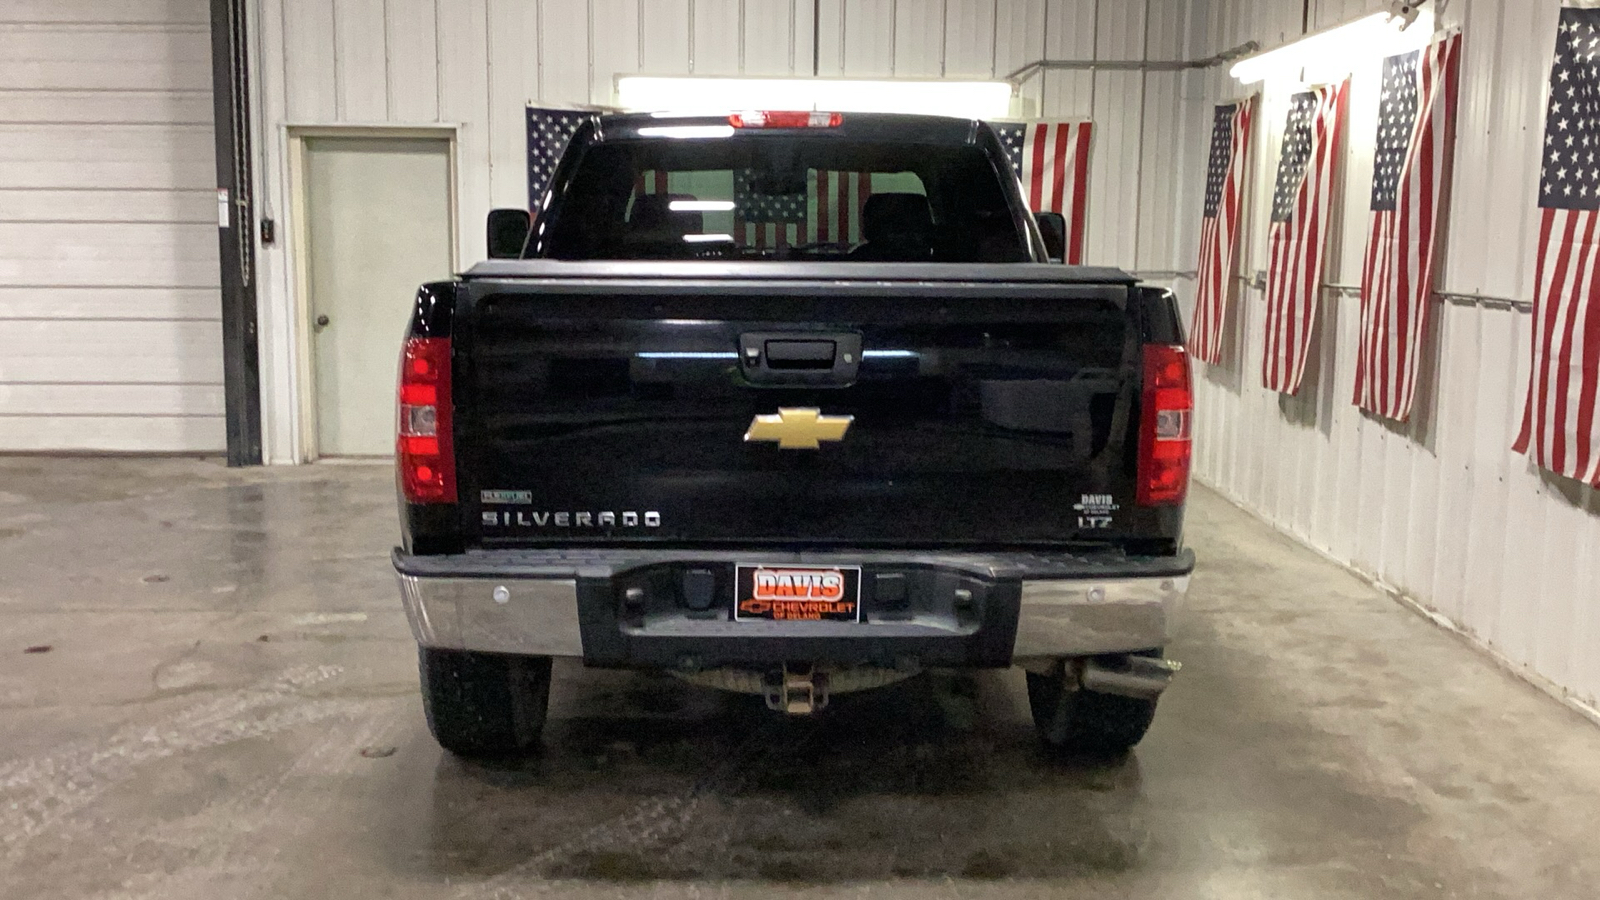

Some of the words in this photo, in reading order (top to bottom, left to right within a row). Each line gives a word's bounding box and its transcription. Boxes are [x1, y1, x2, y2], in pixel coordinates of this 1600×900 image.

[1081, 494, 1113, 505] DAVIS
[481, 511, 661, 527] SILVERADO
[1078, 516, 1112, 529] LTZ
[756, 573, 842, 599] DAVIS
[772, 602, 855, 613] CHEVROLET
[773, 612, 785, 620] OF
